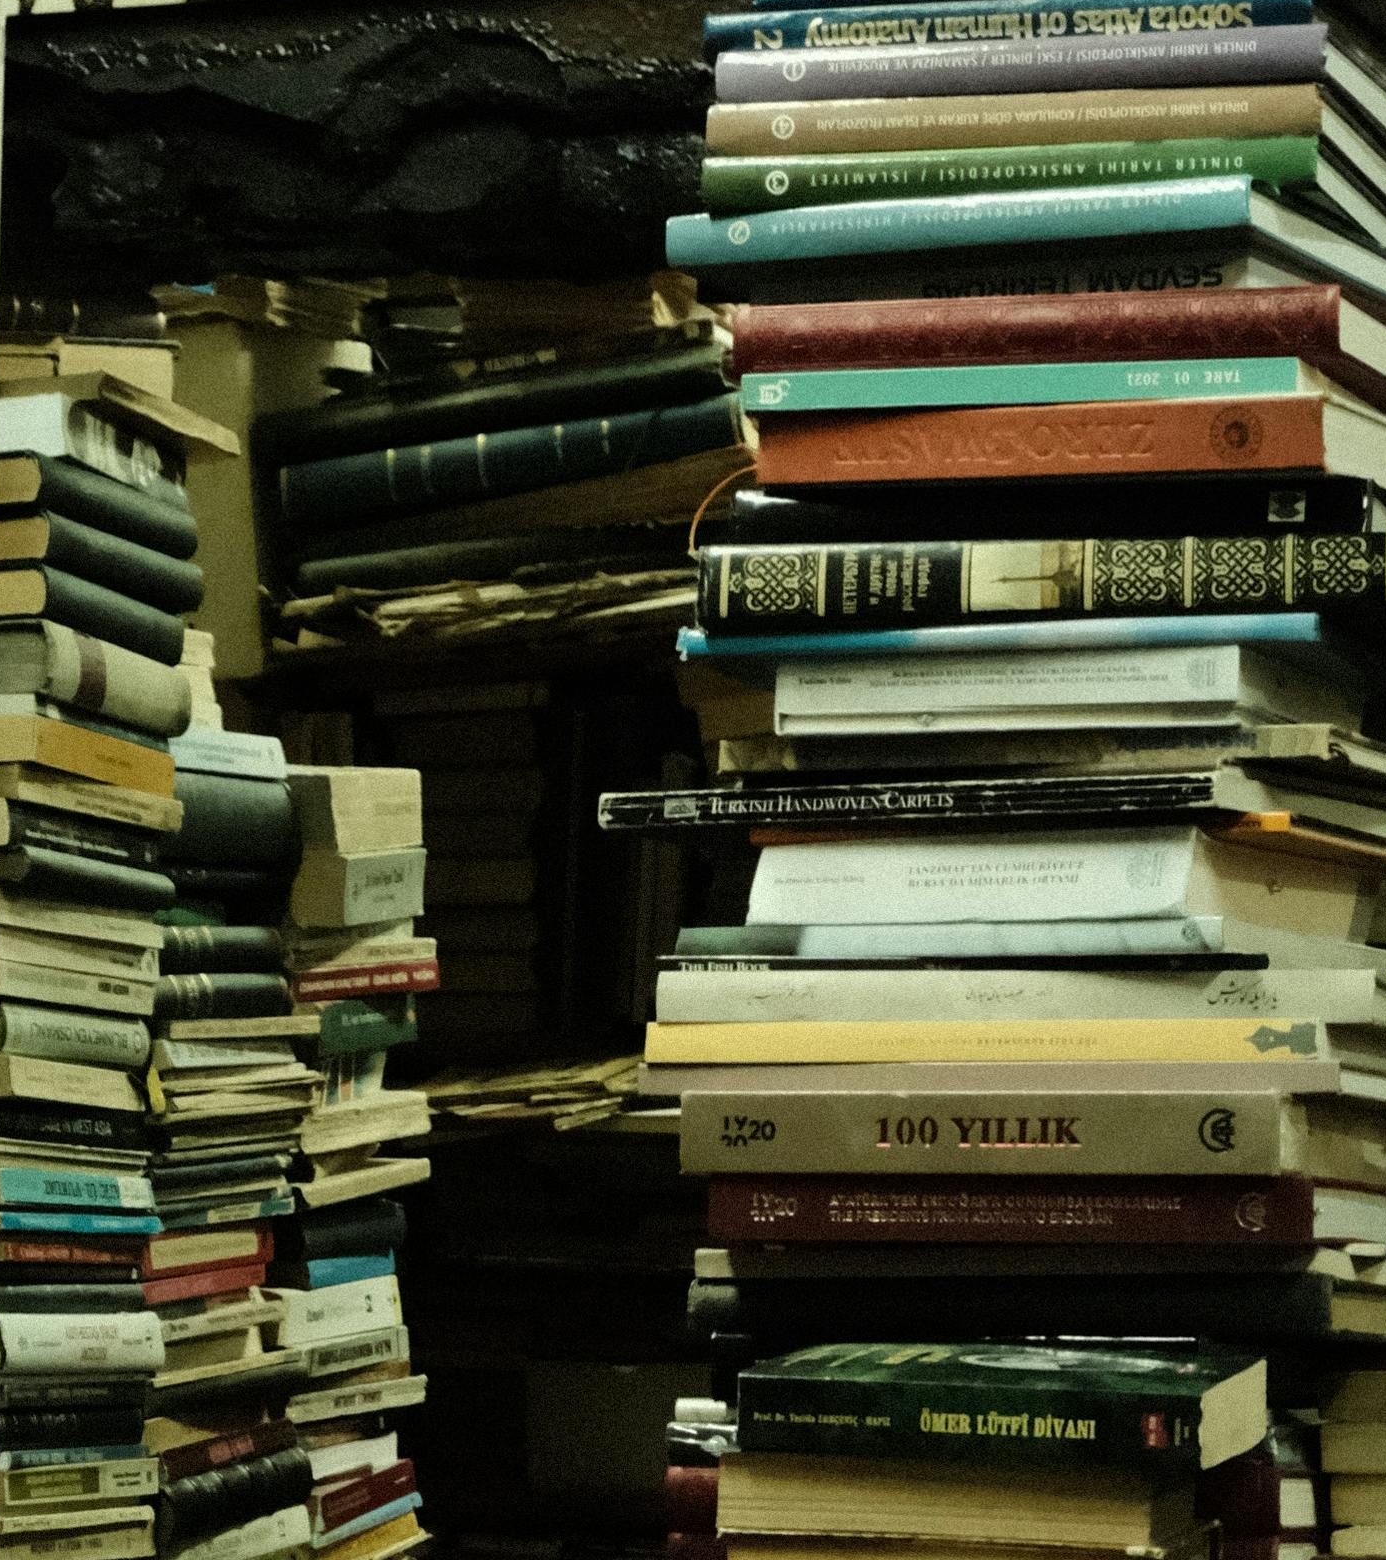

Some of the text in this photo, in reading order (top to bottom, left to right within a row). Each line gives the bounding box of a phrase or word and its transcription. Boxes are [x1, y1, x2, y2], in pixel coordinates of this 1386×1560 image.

[1035, 10, 1067, 40] of
[1072, 7, 1142, 38] Atlas
[876, 1116, 1083, 1148] 100 YILLIK
